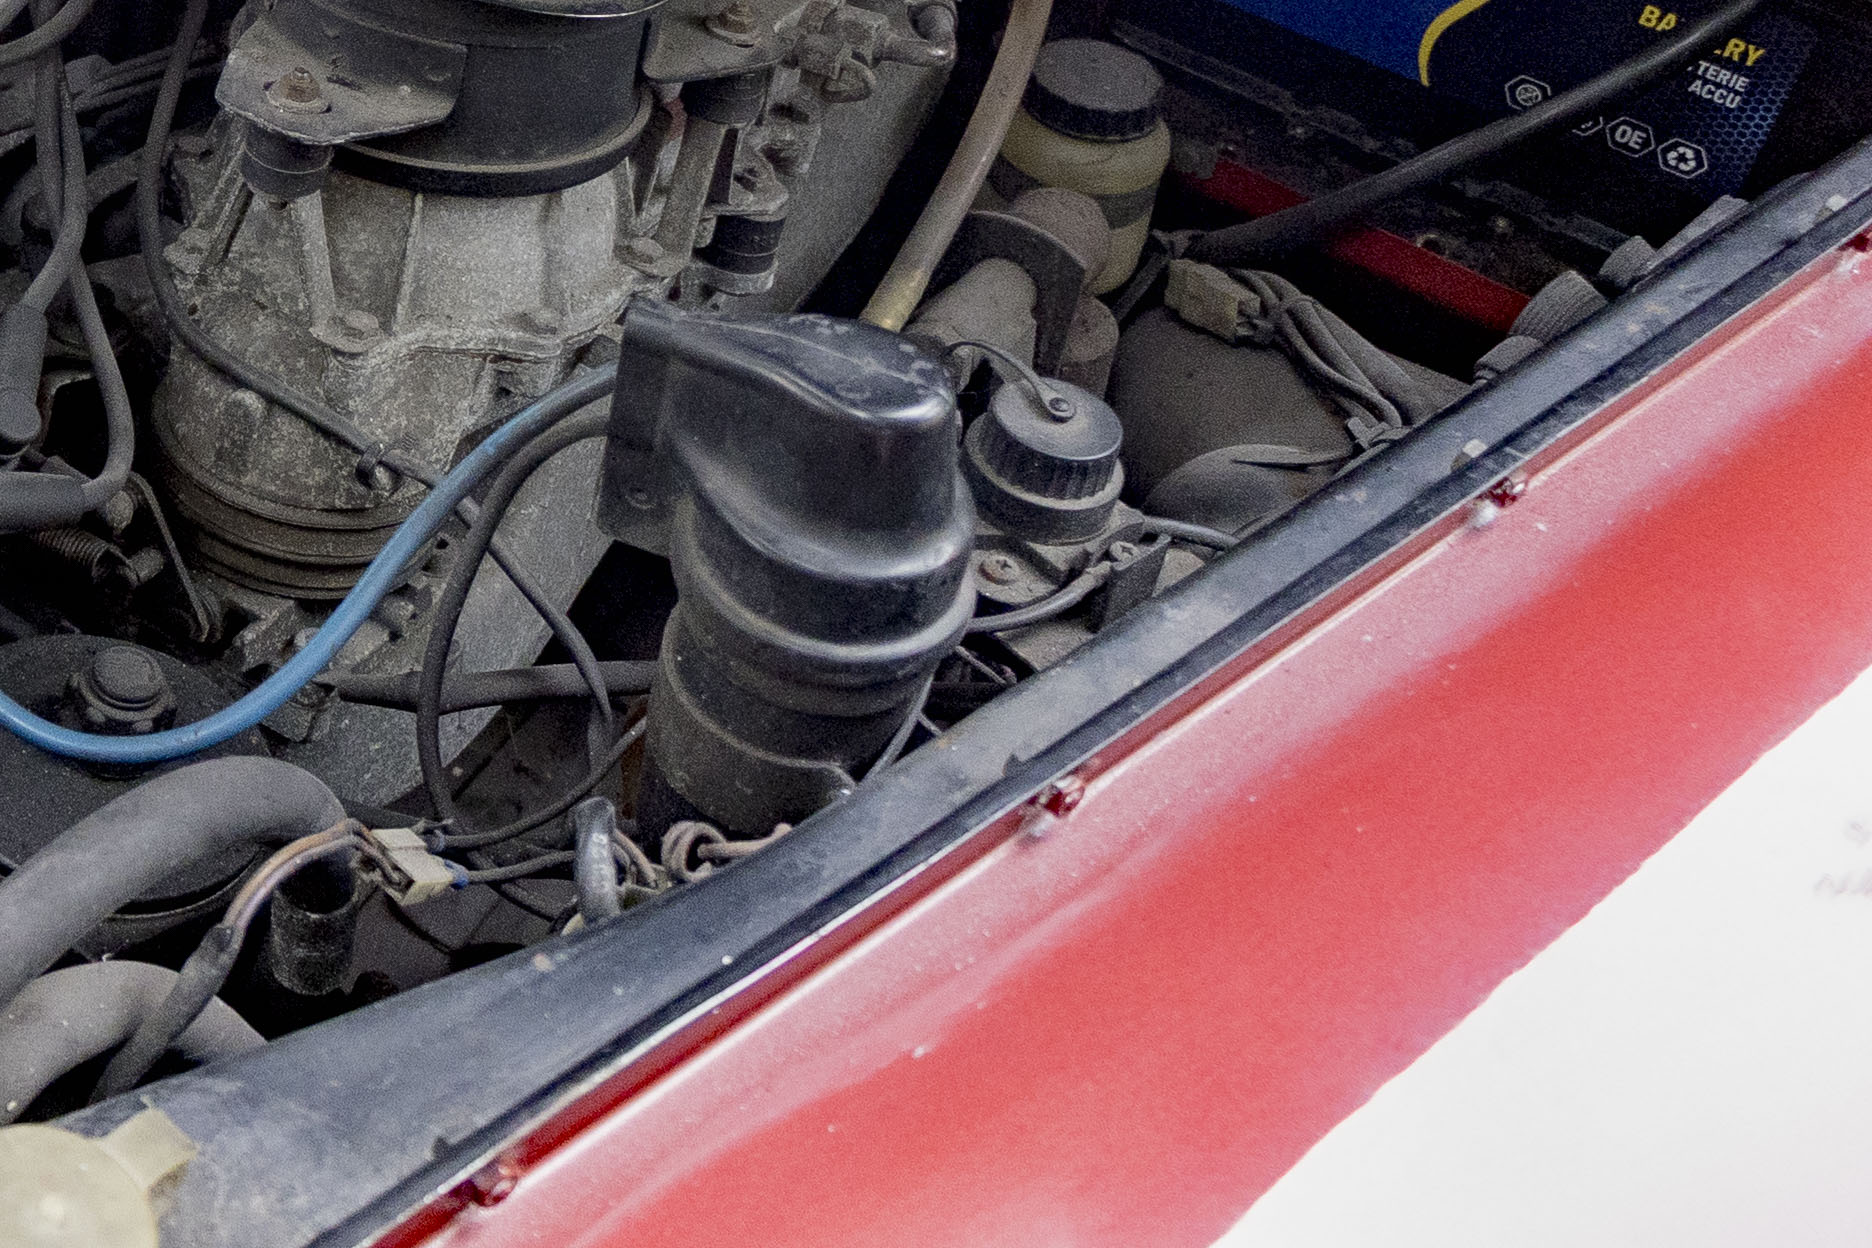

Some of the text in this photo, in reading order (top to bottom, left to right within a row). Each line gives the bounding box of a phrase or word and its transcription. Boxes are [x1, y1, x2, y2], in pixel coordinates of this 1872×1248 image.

[1637, 4, 1766, 68] BARY
[1687, 78, 1743, 109] ACCU
[1614, 123, 1648, 151] OE
